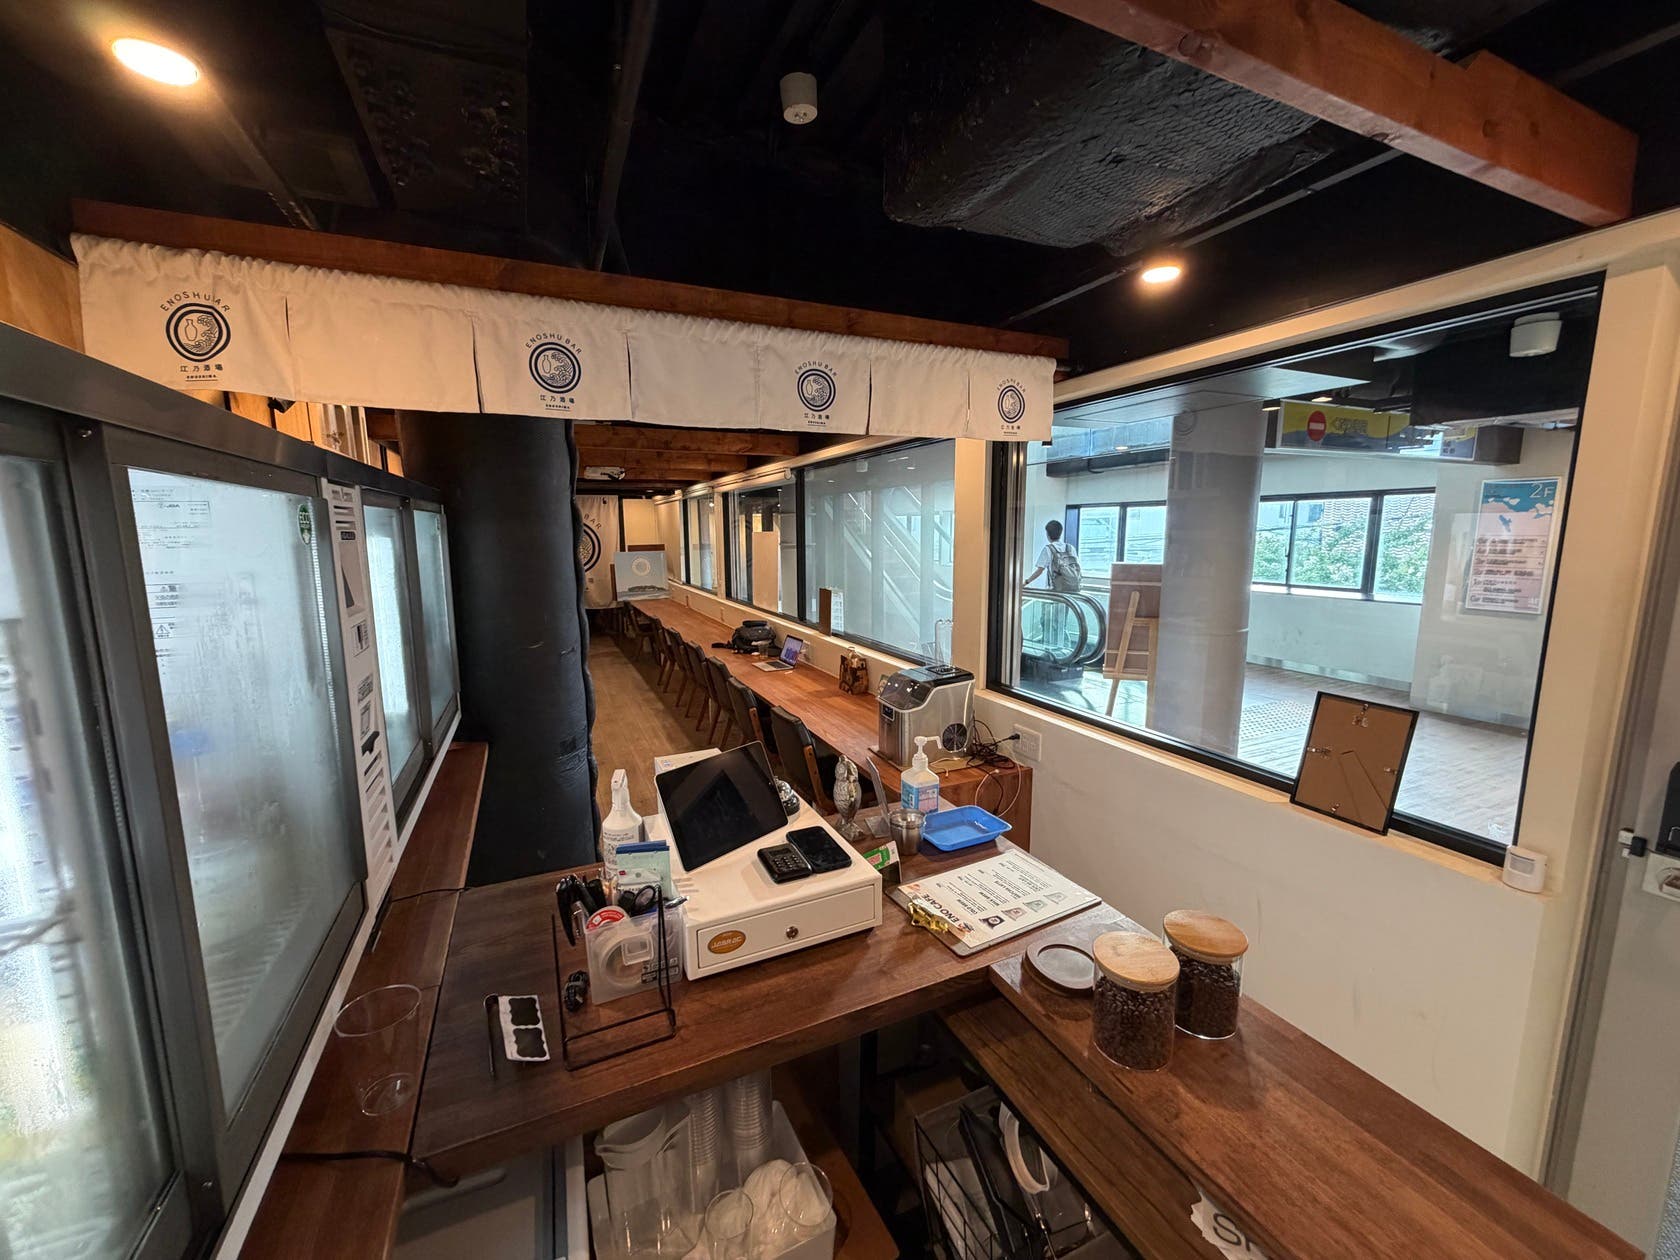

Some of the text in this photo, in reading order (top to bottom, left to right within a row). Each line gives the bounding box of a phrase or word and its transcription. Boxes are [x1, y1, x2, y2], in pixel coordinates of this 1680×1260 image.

[160, 291, 230, 312] ENOSHU AR
[525, 332, 582, 354] ENOSHU BAR
[795, 361, 837, 377] ENOSHU BAR
[1529, 482, 1555, 498] 2F
[921, 893, 943, 910] CAFE
[942, 906, 960, 923] ENO
